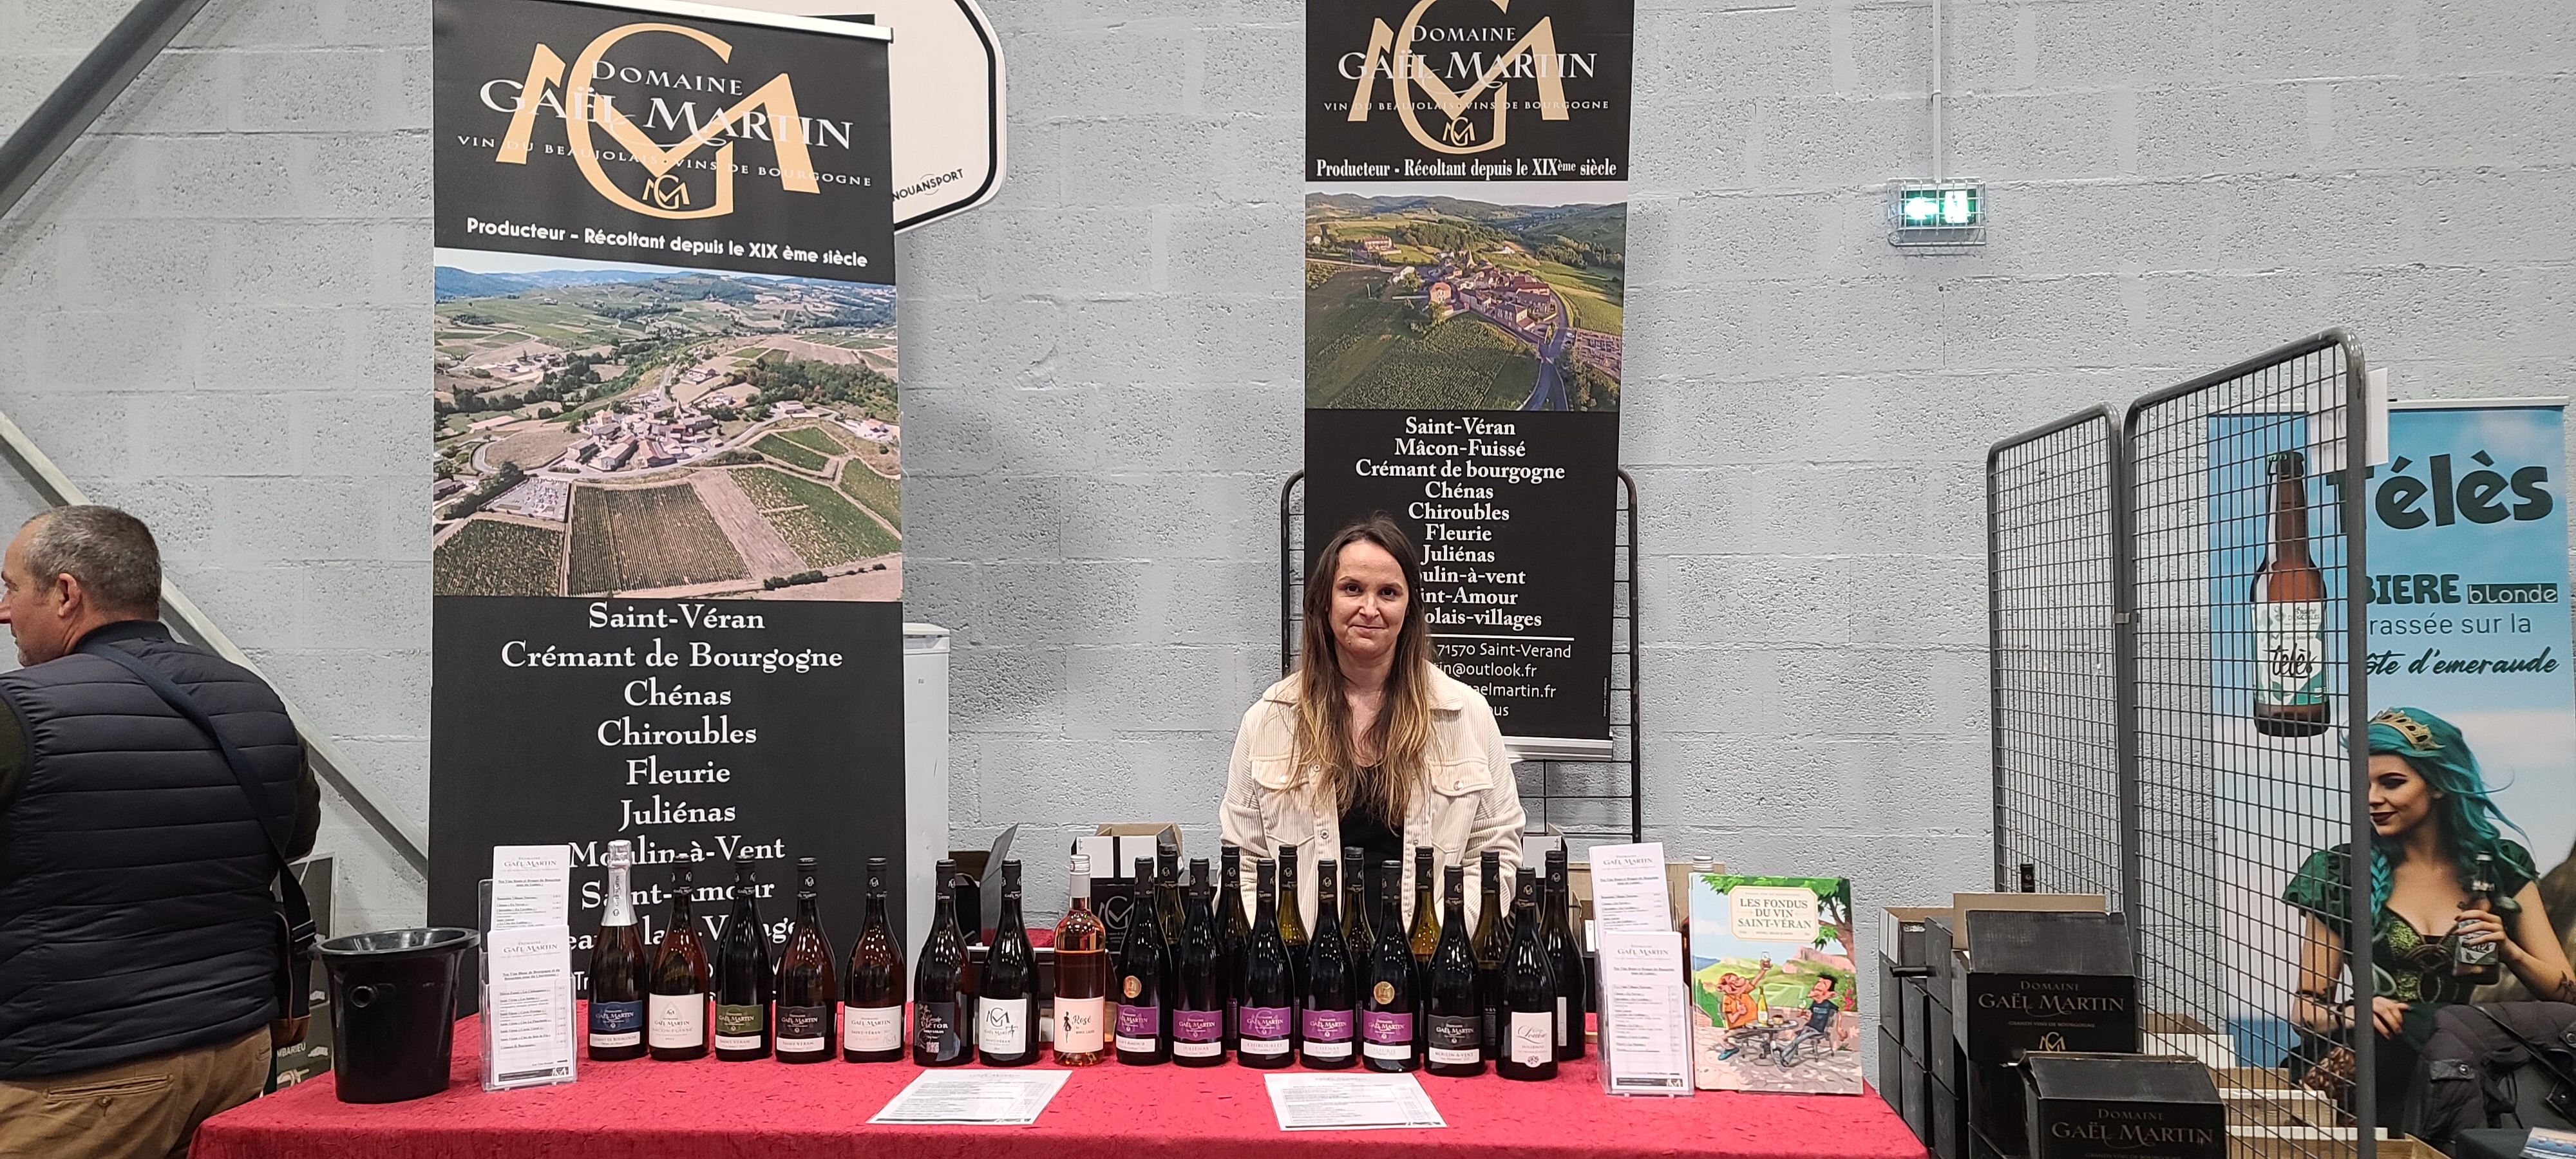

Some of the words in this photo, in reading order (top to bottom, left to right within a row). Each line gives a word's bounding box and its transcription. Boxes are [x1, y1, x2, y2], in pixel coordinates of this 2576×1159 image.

[1410, 24, 1517, 42] DOMAINE
[1338, 49, 1426, 81] GAËL
[1444, 50, 1598, 82] MARTIN
[591, 59, 744, 97] DOMAINE
[480, 78, 628, 131] GAËL
[644, 96, 853, 151] MARTIN
[1379, 102, 1455, 110] BEAUJOLAIS
[1502, 101, 1518, 109] DE
[1524, 100, 1609, 109] BOURGOGNE
[457, 135, 496, 149] VIN
[506, 138, 535, 152] DU
[544, 142, 659, 166] BEAUJOLAIS
[674, 158, 719, 173] VINS
[726, 162, 750, 174] DE
[757, 165, 873, 188] BOURGOGNE
[1316, 159, 1391, 177] Producteur
[1404, 158, 1467, 176] Récoltant
[1470, 158, 1512, 181] depuis
[1516, 158, 1528, 176] le
[1531, 158, 1577, 176] XIXème
[1580, 158, 1617, 176] siècle
[466, 217, 566, 242] Producteur
[583, 225, 667, 251] Récoltant
[670, 233, 725, 259] depuis
[728, 238, 746, 256] le
[749, 241, 779, 261] XIX
[782, 243, 820, 265] ème
[823, 246, 868, 269] siècle
[1405, 416, 1515, 435] Saint-Véran
[1394, 437, 1526, 458] Mâcon-Fuissé
[1356, 458, 1437, 478] Crémant
[1440, 460, 1463, 478] de
[1466, 460, 1566, 484] bourgogne
[1425, 481, 1494, 500] Chénas
[1408, 501, 1510, 521] Chiroubles
[1425, 523, 1492, 542] Fleurie
[1419, 544, 1495, 565] Juliénas
[1420, 565, 1526, 585] ulin-à-vent
[1419, 586, 1519, 606] int-Amour
[589, 601, 765, 630] Saint-Véran
[1424, 607, 1543, 632] olais-villages
[2369, 612, 2453, 636] rassée
[2461, 617, 2502, 634] sur
[2511, 613, 2532, 634] la
[501, 641, 636, 668] Crémant
[645, 639, 679, 667] de
[689, 642, 843, 673] Bourgogne
[1437, 644, 1475, 657] 71570
[1479, 643, 1572, 659] Saint-Verand
[2365, 649, 2406, 675] ôte
[2408, 646, 2561, 675] d'emeraude
[623, 677, 732, 707] Chénas
[597, 715, 757, 746] Chiroubles
[625, 755, 731, 786] Fleurie
[618, 794, 736, 832] Juliénas
[1740, 898, 1760, 907] LES
[1763, 899, 1808, 909] FONDUS
[1755, 909, 1770, 917] DU
[1773, 909, 1794, 918] VIN
[1738, 918, 1812, 928] SAINT-VÉRAN
[2020, 981, 2081, 991] DOMAINE
[1978, 993, 2029, 1009] GAËL
[2040, 994, 2124, 1012] MARTIN
[2098, 1109, 2164, 1121] DOMAINE
[2051, 1122, 2110, 1139] GAËL
[2119, 1124, 2213, 1145] MARTIN
